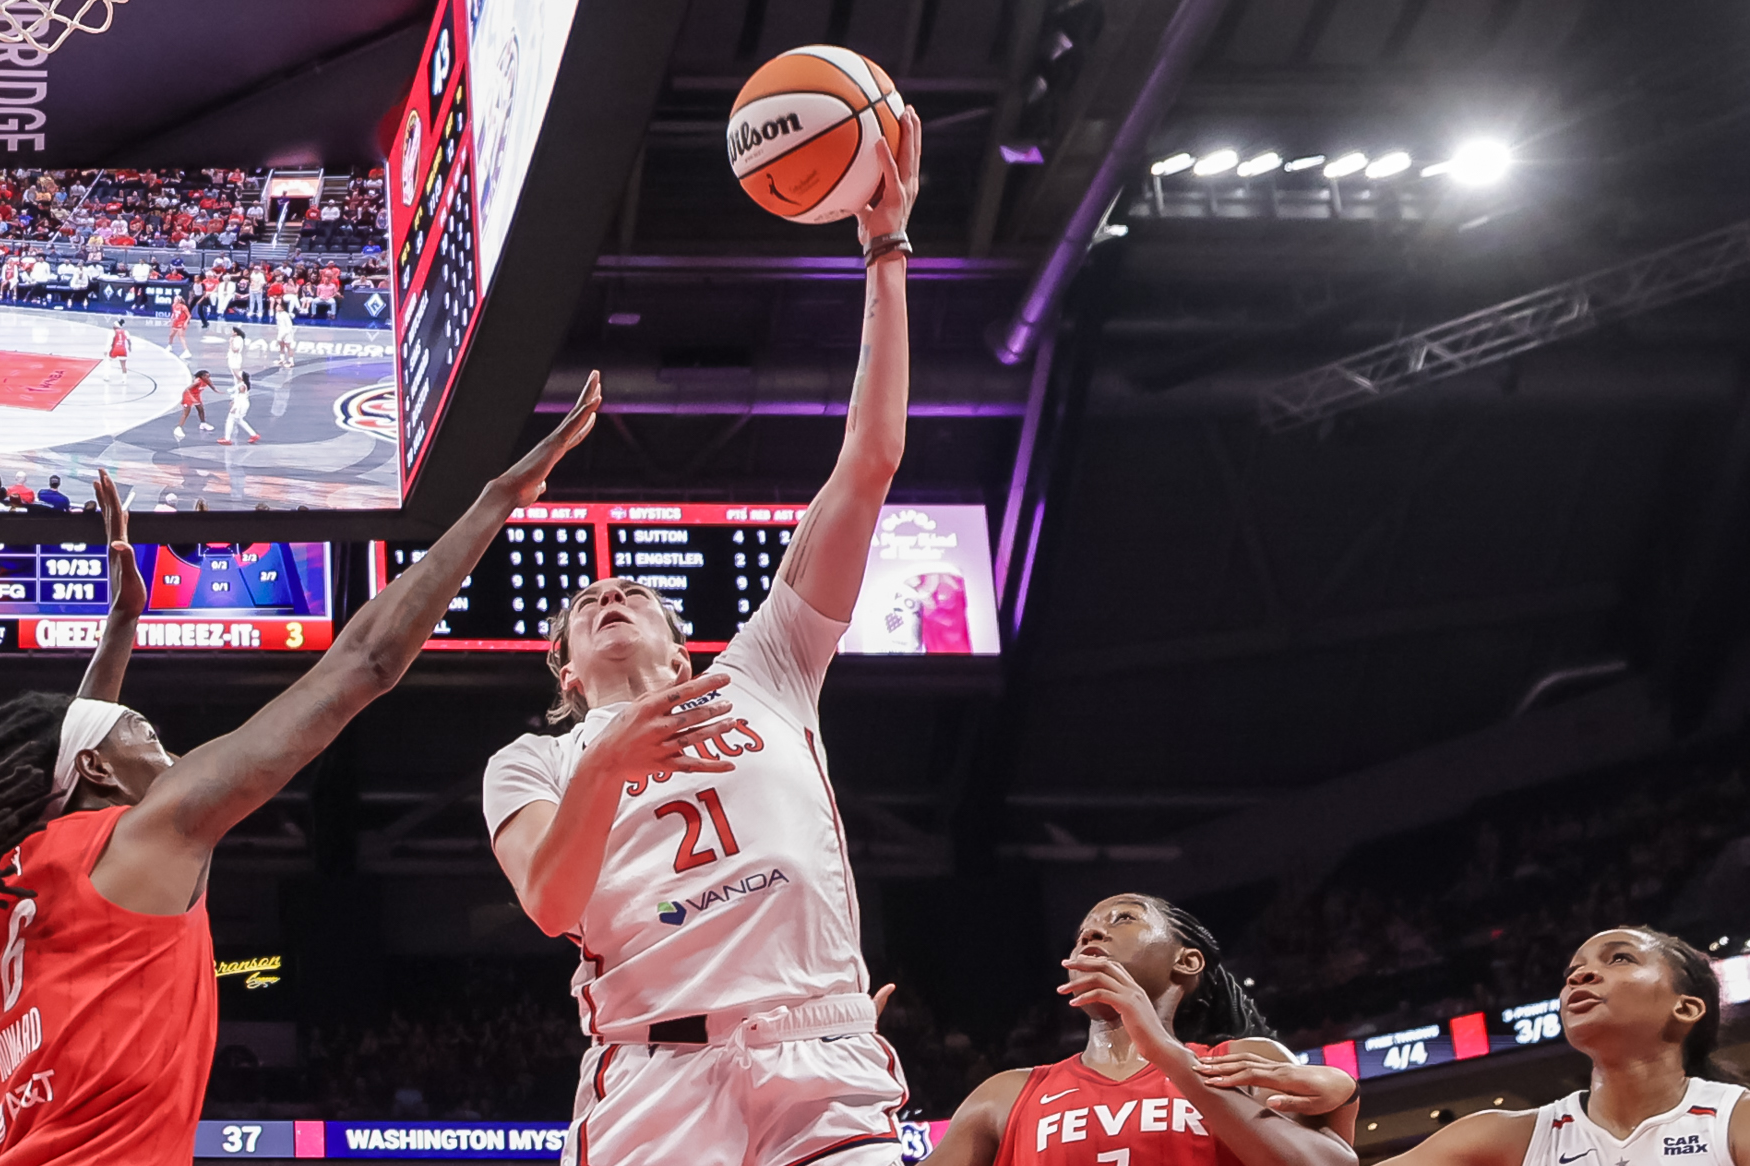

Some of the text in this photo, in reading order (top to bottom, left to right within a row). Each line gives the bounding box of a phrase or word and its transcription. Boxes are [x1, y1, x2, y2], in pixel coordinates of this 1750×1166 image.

[629, 508, 682, 520] MYSTICS
[726, 508, 748, 520] PTS
[506, 528, 525, 543] 10
[633, 529, 688, 544] SUTTON
[45, 559, 103, 576] 19/33
[615, 553, 704, 568] 21 ENGSTLER
[52, 583, 95, 600] 3/11
[637, 576, 688, 590] CITRON
[35, 619, 303, 648] CHEEZ- THREEZ-IT: 3
[679, 690, 722, 711] max
[654, 787, 740, 873] 21
[686, 869, 789, 911] VANDA
[213, 955, 281, 977] ranson
[1514, 1013, 1561, 1044] 3/8
[1383, 1042, 1429, 1070] 4/4
[1036, 1098, 1209, 1152] FEVER
[222, 1125, 262, 1152] 37
[346, 1129, 505, 1151] WASHINGTON
[1663, 1135, 1700, 1147] CAR
[1663, 1143, 1708, 1156] max
